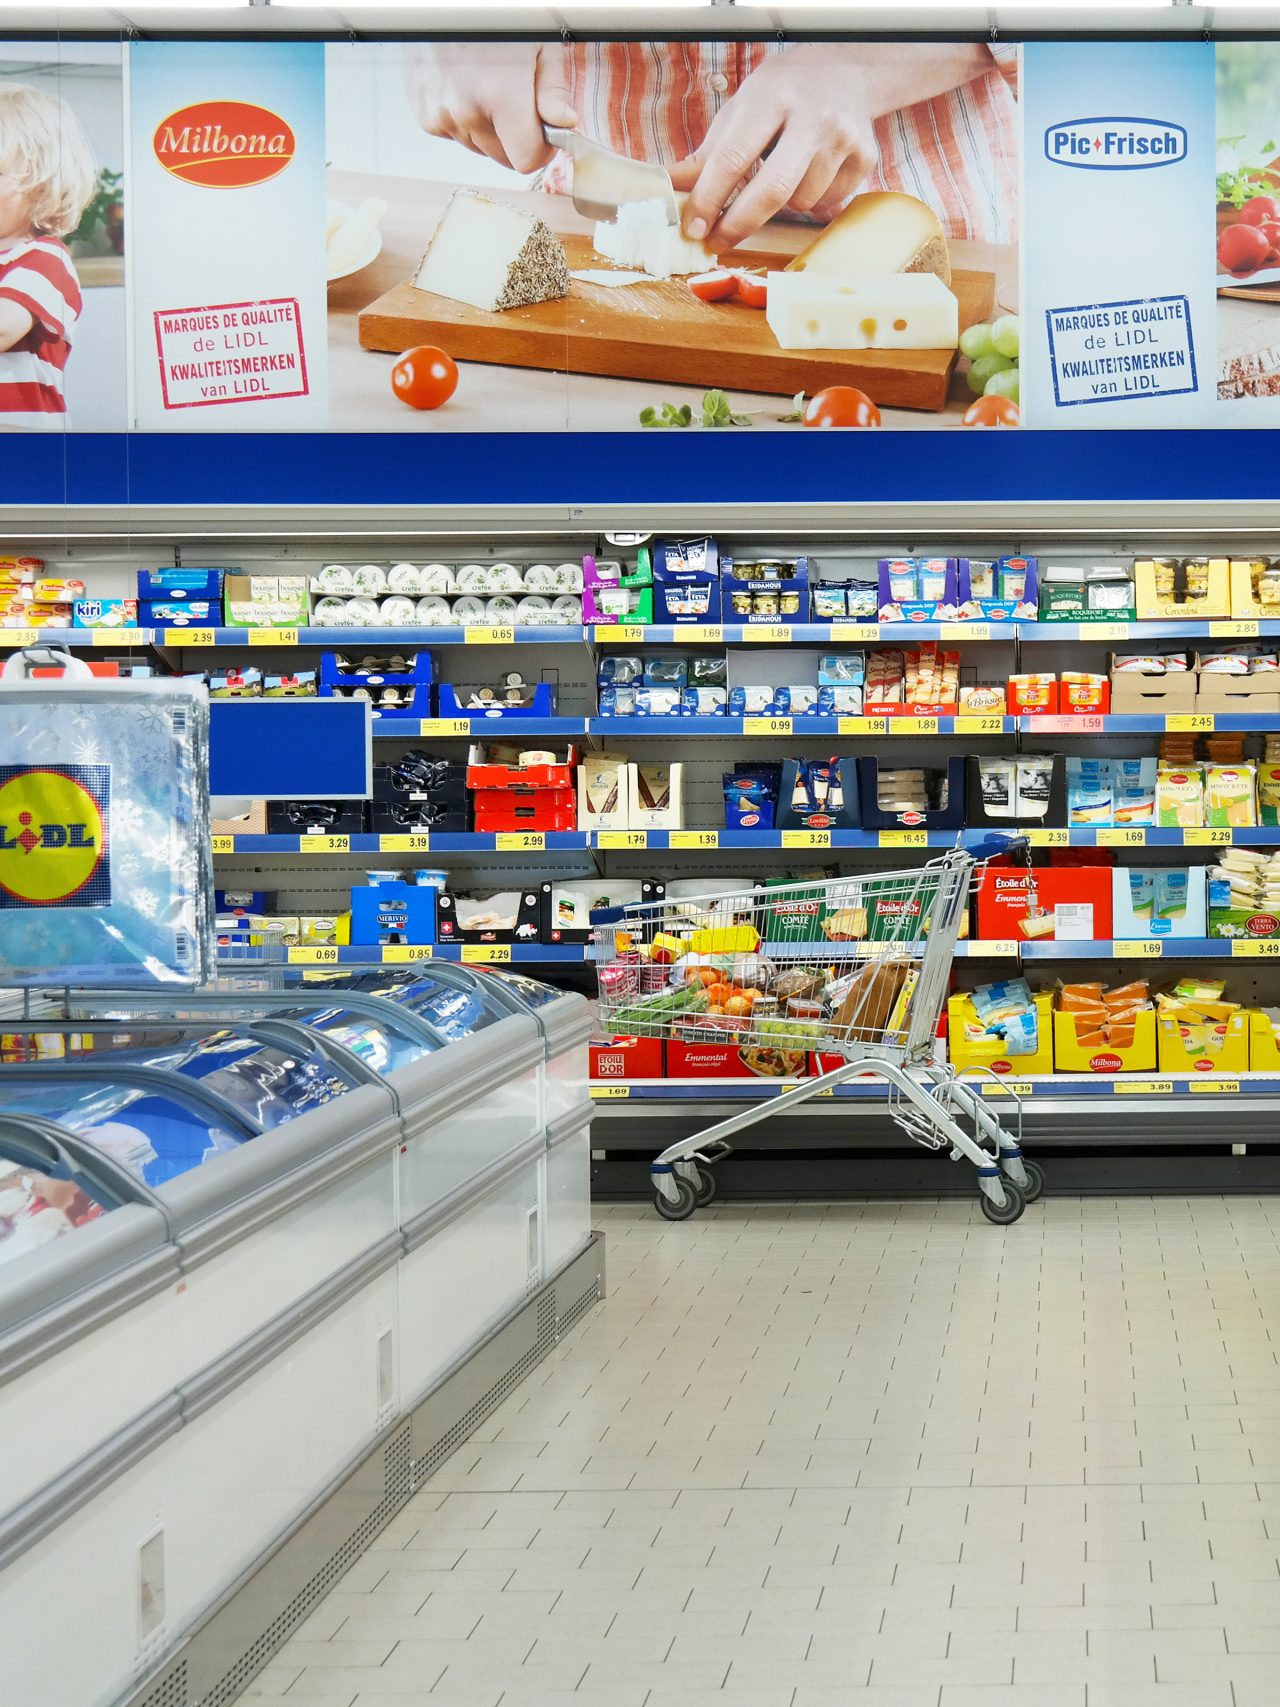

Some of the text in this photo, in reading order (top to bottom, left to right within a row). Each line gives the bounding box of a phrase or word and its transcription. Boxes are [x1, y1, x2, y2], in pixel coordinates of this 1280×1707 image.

[158, 123, 286, 155] Milbona
[163, 305, 293, 334] MARQUES DE QUALITÉ
[1055, 302, 1183, 332] MARQUES DE QUALITÉ
[193, 331, 269, 353] de LIDL
[1084, 328, 1159, 350] de LIDL
[170, 353, 295, 381] KWALITEITSMERKEN
[1062, 350, 1185, 378] KWALITEITSMERKEN
[201, 377, 270, 397] van LIDL
[1091, 377, 1160, 395] van LIDL
[76, 601, 100, 615] kiri
[624, 629, 642, 637] 1.79
[703, 629, 721, 637] 1.69
[771, 629, 789, 637] 1.89
[970, 627, 988, 636] 1.99
[1236, 624, 1257, 633] 2.85
[16, 633, 36, 641] 2.35
[193, 633, 212, 642] 2.39
[279, 632, 296, 641] 1.41
[492, 629, 512, 639] 0.65
[861, 629, 878, 638] 1.29
[771, 721, 790, 730] 0.99
[867, 721, 885, 730] 1.99
[918, 720, 936, 729] 1.89
[981, 720, 1001, 729] 2.22
[1082, 718, 1101, 728] 1.59
[1191, 717, 1212, 727] 2.45
[453, 722, 469, 732] 1.19
[523, 836, 543, 846] 2.99
[627, 835, 645, 844] 1.79
[699, 835, 717, 844] 1.39
[810, 835, 829, 844] 3.29
[903, 834, 926, 843] 16.45
[1048, 832, 1067, 842] 2.39
[1125, 832, 1143, 841] 1.69
[1211, 832, 1231, 841] 2.29
[212, 839, 231, 849] 3.99
[329, 838, 348, 848] 3.29
[409, 838, 427, 847] 3.19
[996, 876, 1019, 888] Étoile
[1250, 923, 1276, 931] VENTO
[995, 944, 1016, 952] 6.25
[1143, 944, 1161, 953] 1.69
[1258, 944, 1279, 954] 3.49
[316, 949, 336, 960] 0.69
[409, 949, 430, 959] 0.85
[490, 949, 509, 959] 2.29
[600, 1056, 623, 1064] ETOILE
[685, 1053, 728, 1062] Emmental
[1090, 1059, 1122, 1069] Milbona
[1150, 1083, 1171, 1091] 3.89
